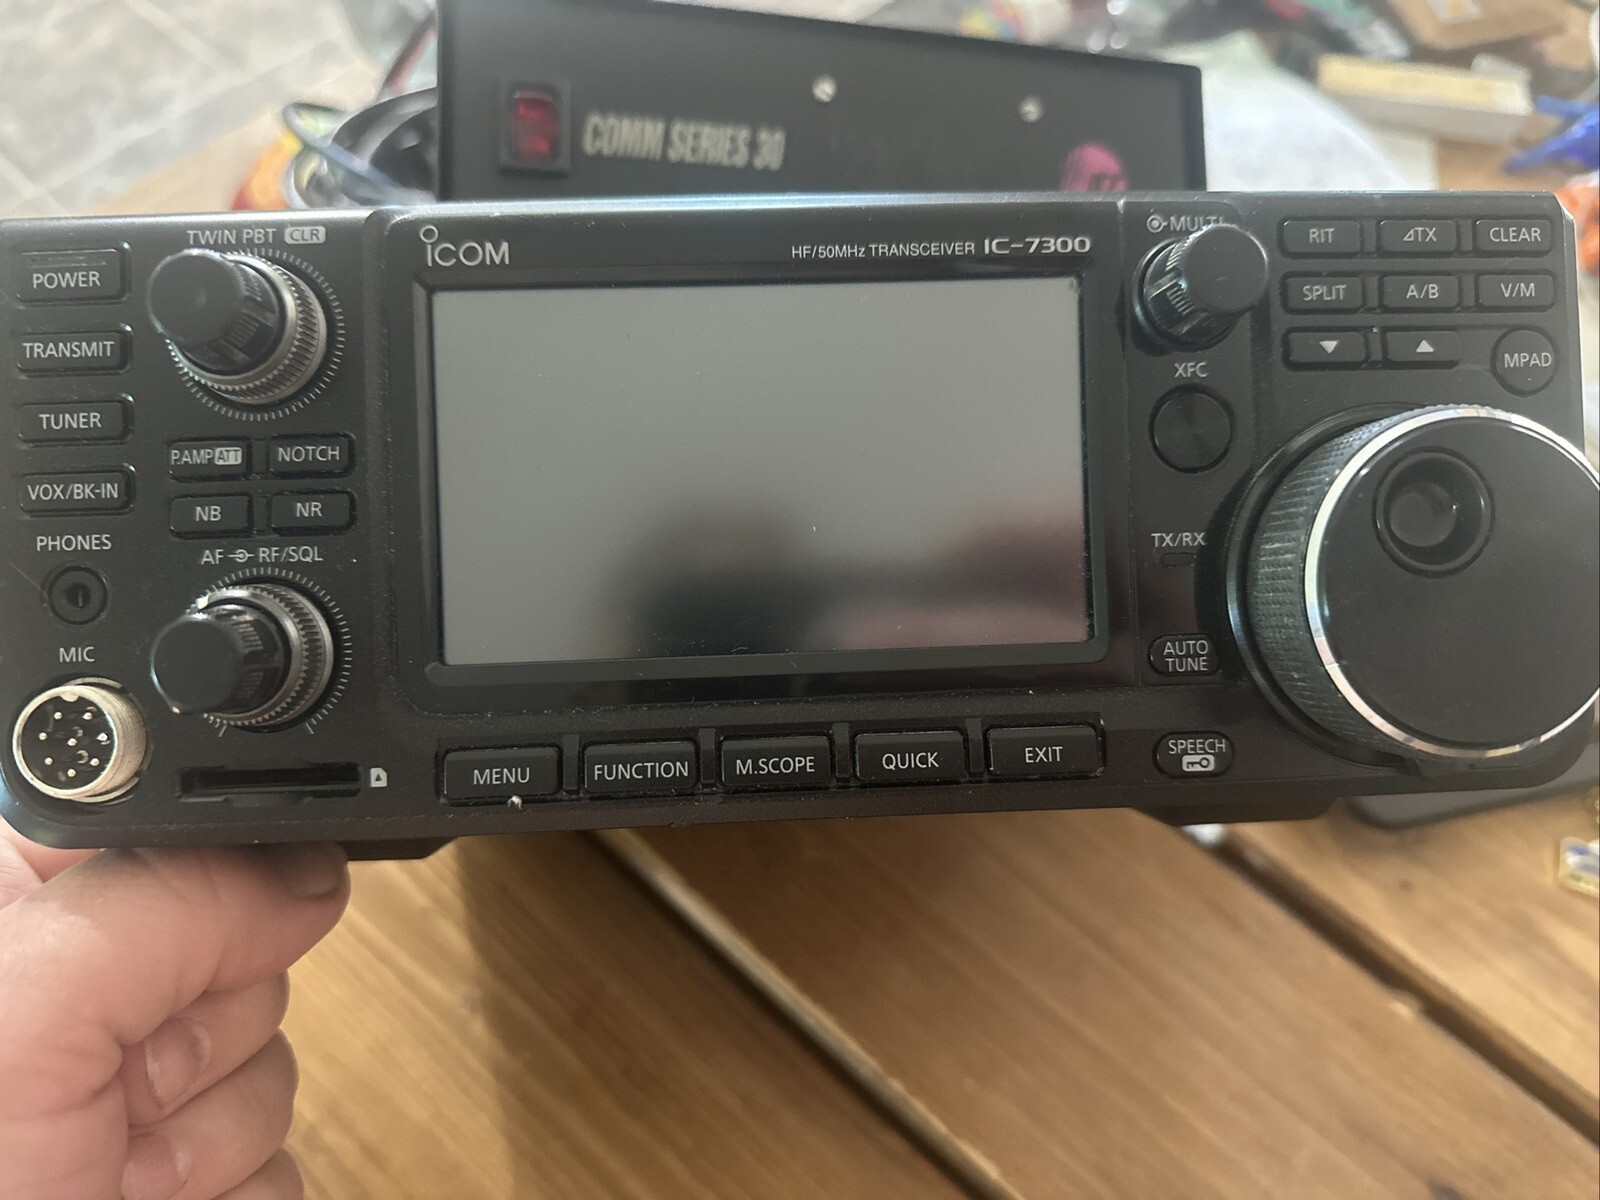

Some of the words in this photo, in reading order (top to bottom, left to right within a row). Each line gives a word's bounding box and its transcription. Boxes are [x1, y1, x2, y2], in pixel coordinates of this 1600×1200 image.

[583, 114, 667, 161] COMM
[667, 118, 752, 169] SERIES
[187, 228, 236, 246] TWIN
[242, 228, 277, 245] PBT
[288, 228, 323, 242] CLR
[1309, 227, 1335, 244] RIT
[1489, 226, 1542, 243] CLEAR
[791, 245, 866, 260] HF/50MHz
[868, 242, 976, 258] TRANSCEIVER
[984, 236, 1092, 255] IC-7300
[32, 271, 102, 289] POWER
[1302, 284, 1347, 302] SPLIT
[1406, 284, 1440, 300] A/B
[1500, 282, 1536, 299] V/M
[22, 340, 115, 358] TRANSMIT
[1503, 351, 1553, 369] MPAD
[1174, 361, 1208, 379] XFC
[39, 412, 102, 430] TUNER
[216, 448, 241, 464] ATT
[277, 445, 341, 462] NOTCH
[27, 483, 119, 500] VOX/BK-IN
[195, 505, 222, 521] NB
[296, 502, 323, 517] NR
[36, 534, 112, 551] PHONES
[1150, 532, 1206, 547] TX/RX
[201, 549, 225, 565] AF
[259, 546, 324, 563] RF/SQL
[58, 646, 95, 663] MIC
[1163, 640, 1209, 656] AUTO
[1165, 656, 1209, 672] TUNE
[1024, 746, 1064, 763] EXIT
[1167, 738, 1227, 754] SPEECH
[735, 756, 816, 775] M.SCOPE
[881, 752, 940, 770] QUICK
[472, 766, 532, 785] MENU
[593, 761, 690, 781] FUNCTION
